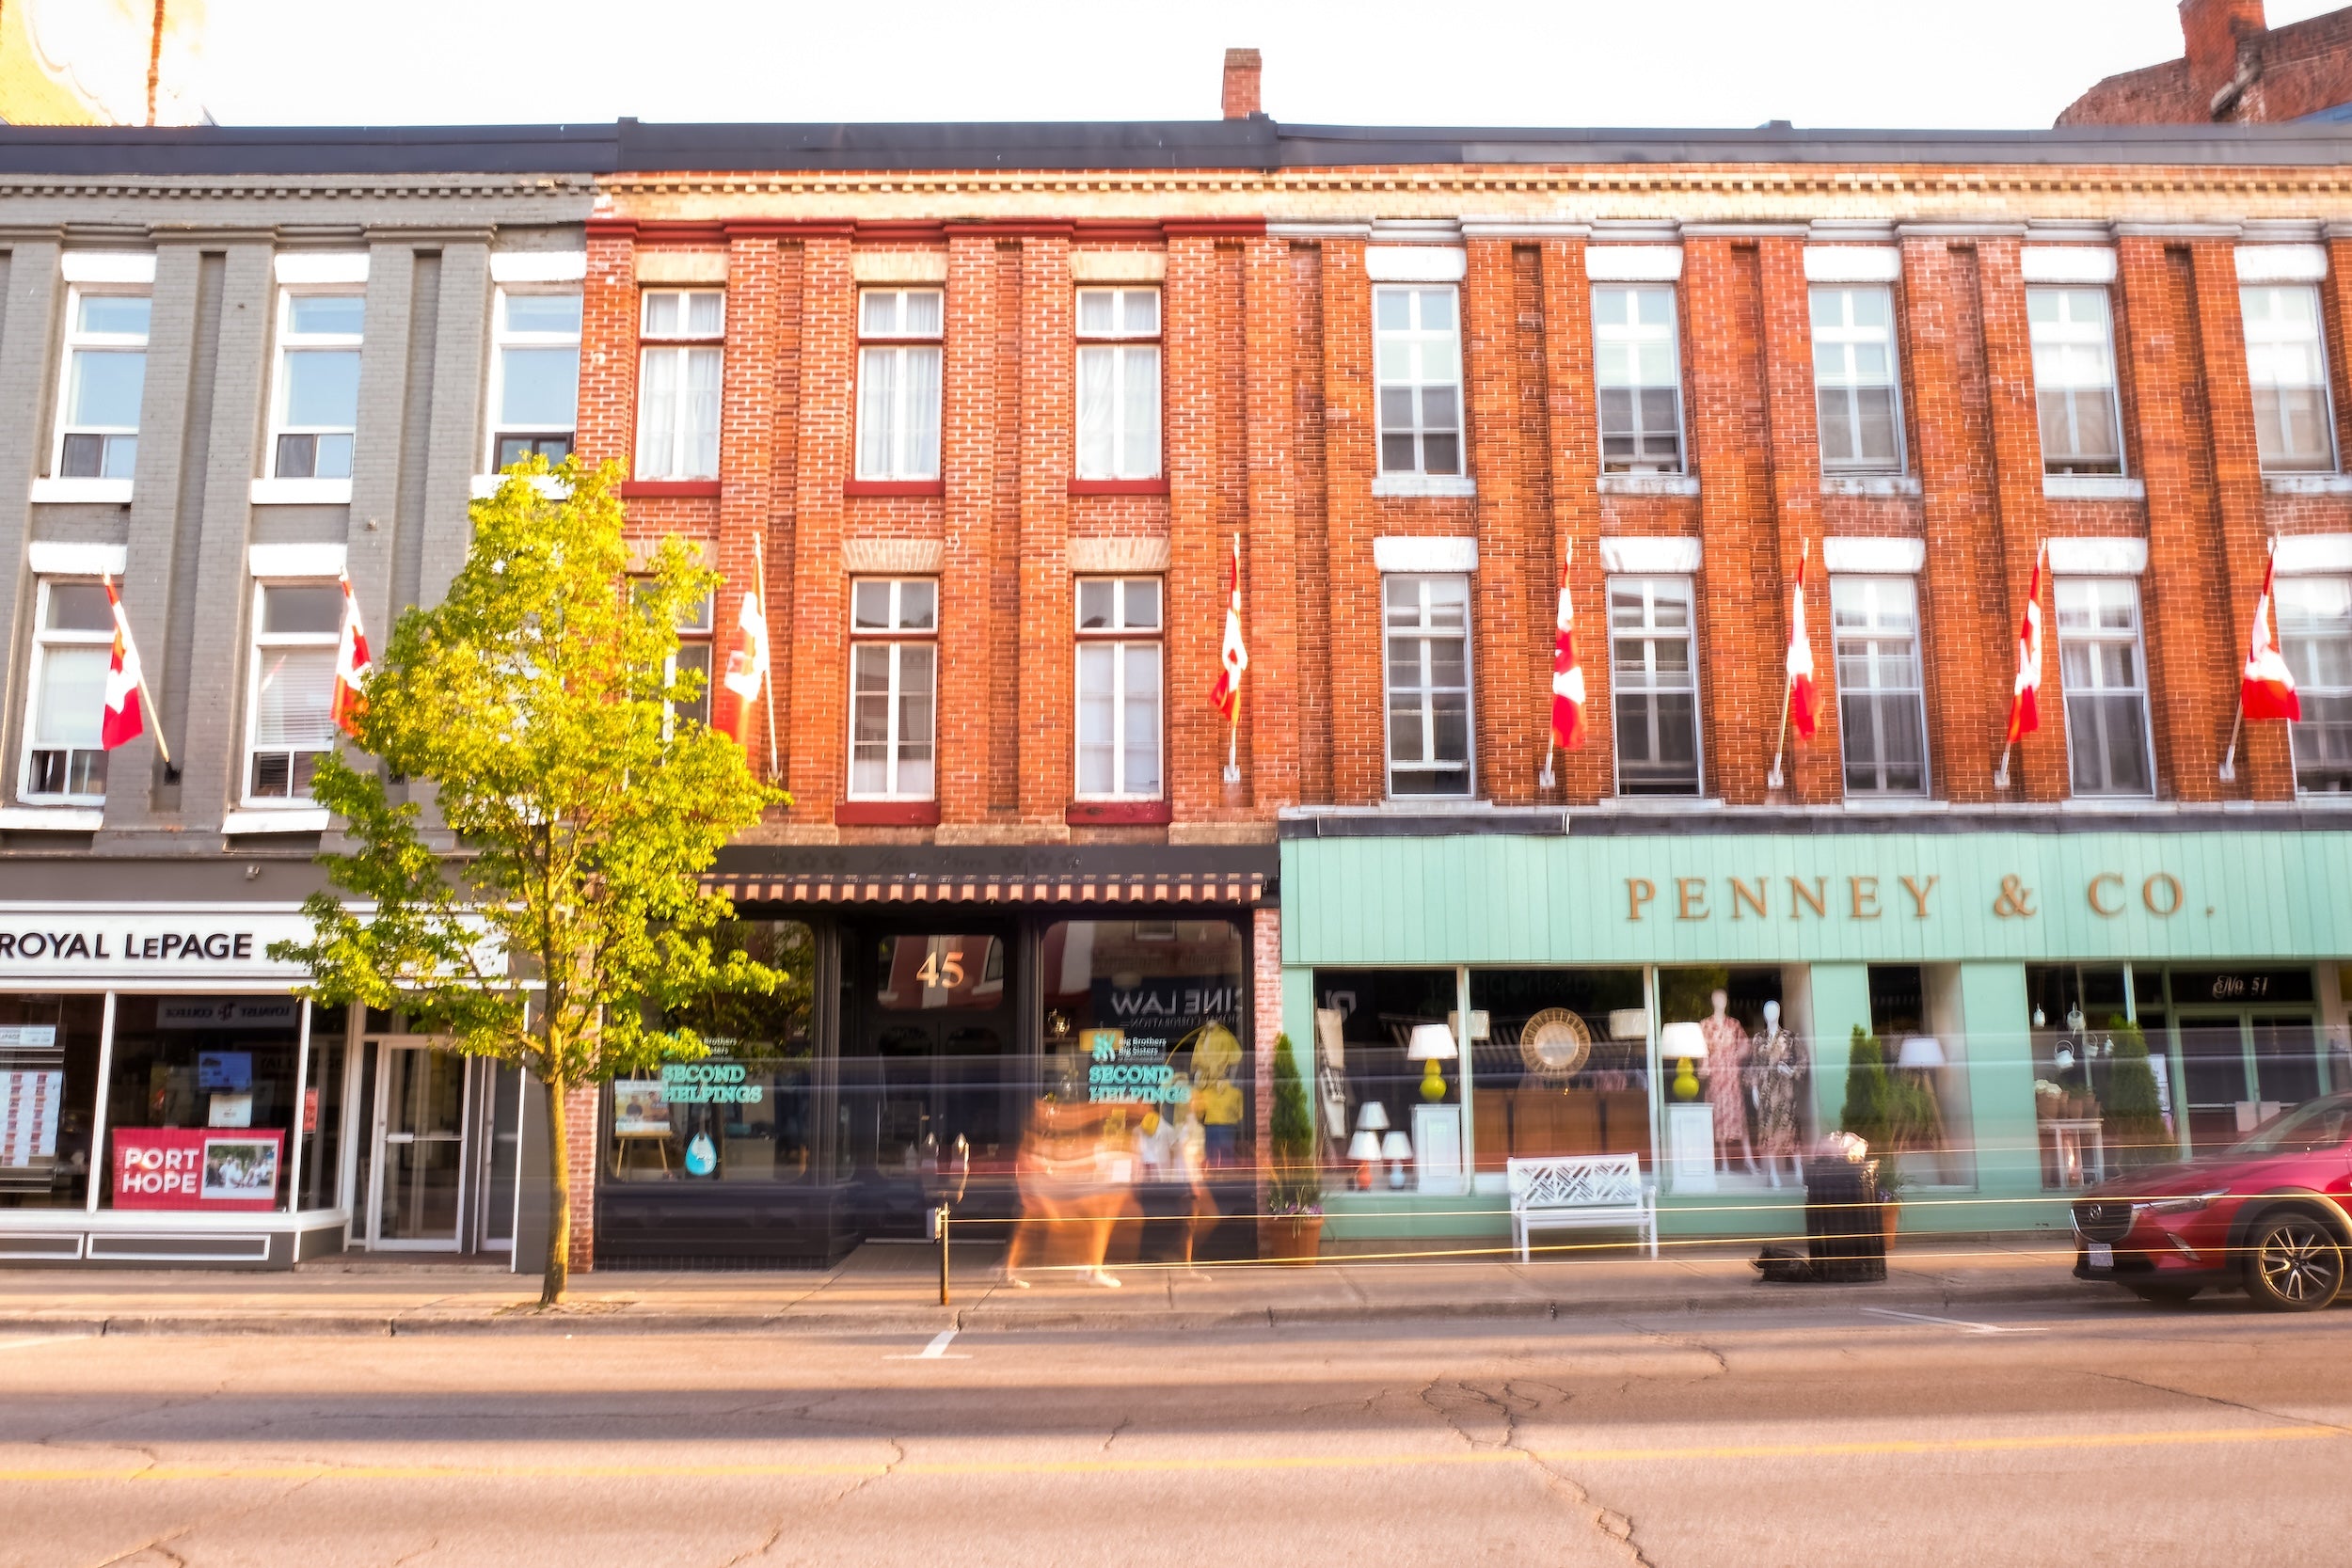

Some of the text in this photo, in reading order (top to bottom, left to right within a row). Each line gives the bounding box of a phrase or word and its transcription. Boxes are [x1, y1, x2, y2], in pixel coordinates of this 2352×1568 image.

[1625, 872, 2216, 921] PENNEY & CO.
[0, 932, 110, 958] ROYAL
[916, 951, 964, 989] 45
[2251, 977, 2268, 995] 51
[704, 1037, 738, 1046] Brothers
[1118, 1037, 1168, 1048] Big Brothers
[1118, 1046, 1159, 1058] Big Sisters
[661, 1064, 746, 1084] SECOND
[1089, 1064, 1175, 1084] SECOND
[660, 1085, 763, 1103] HELPINGS
[1089, 1085, 1191, 1104] HELPINGS
[124, 1148, 200, 1170] PORT
[121, 1171, 199, 1195] HOPE
